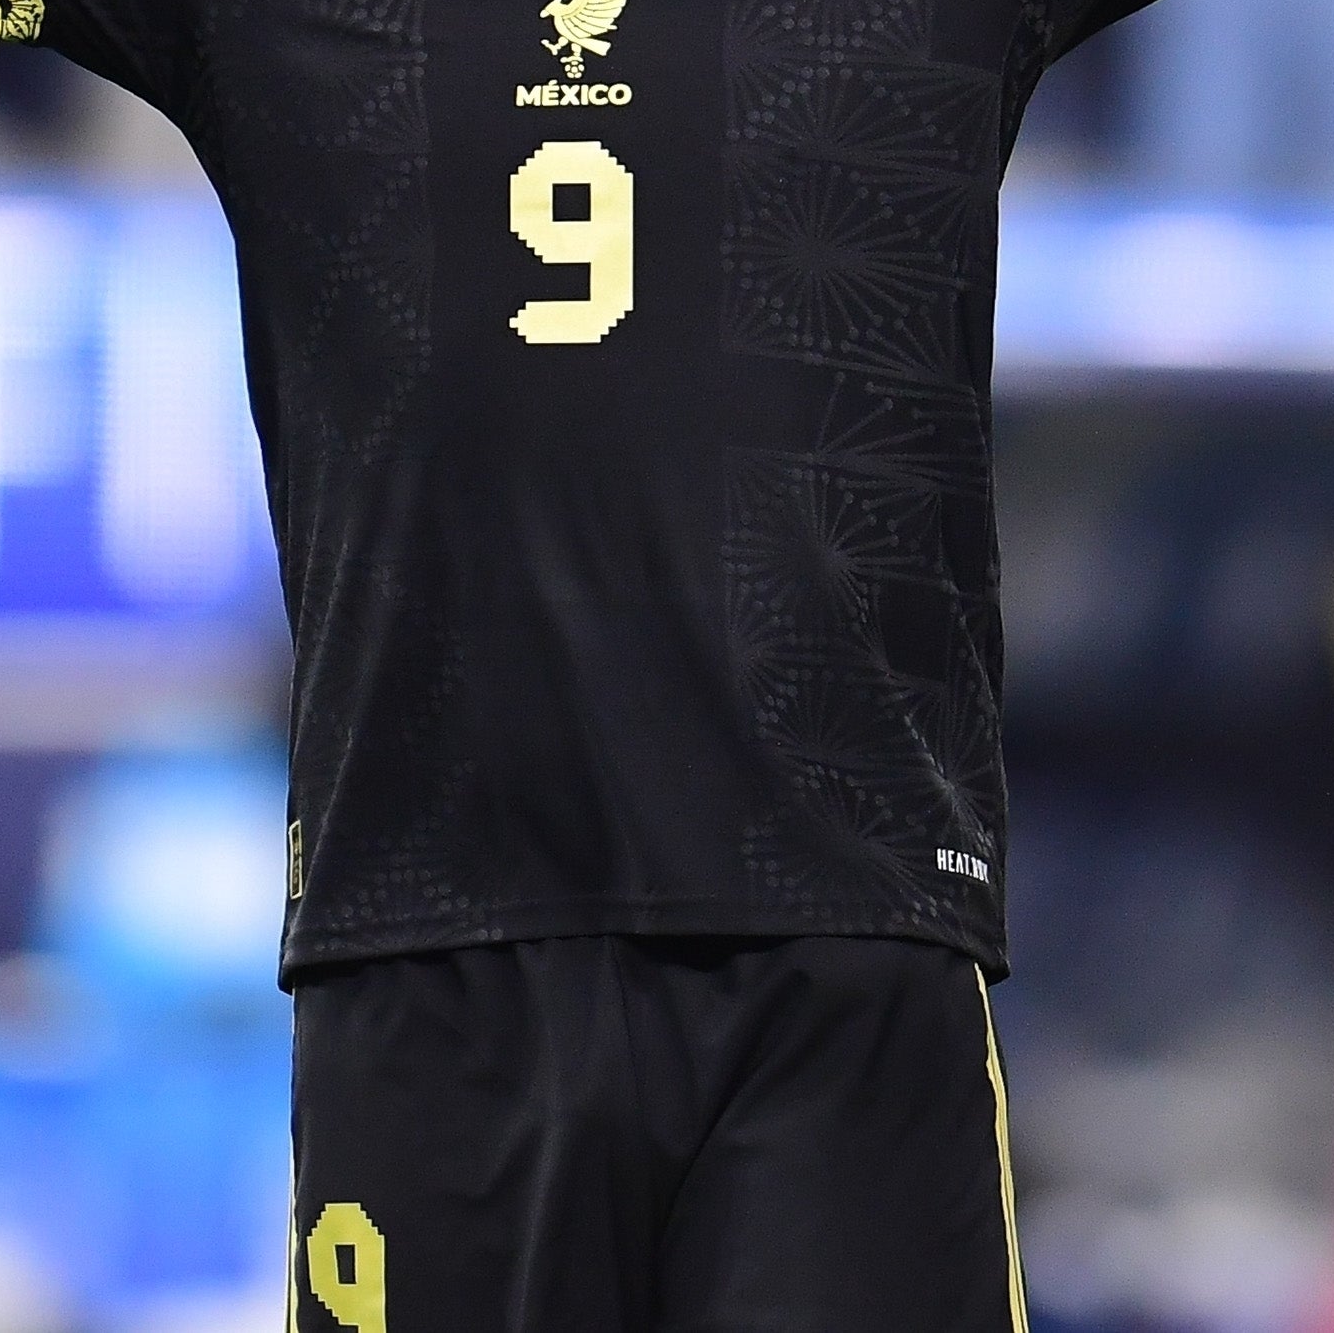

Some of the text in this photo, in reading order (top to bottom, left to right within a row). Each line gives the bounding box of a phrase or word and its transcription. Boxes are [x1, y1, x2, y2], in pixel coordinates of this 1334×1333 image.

[515, 80, 633, 107] MÉXICO
[509, 141, 634, 344] 9
[307, 1202, 387, 1333] 9
